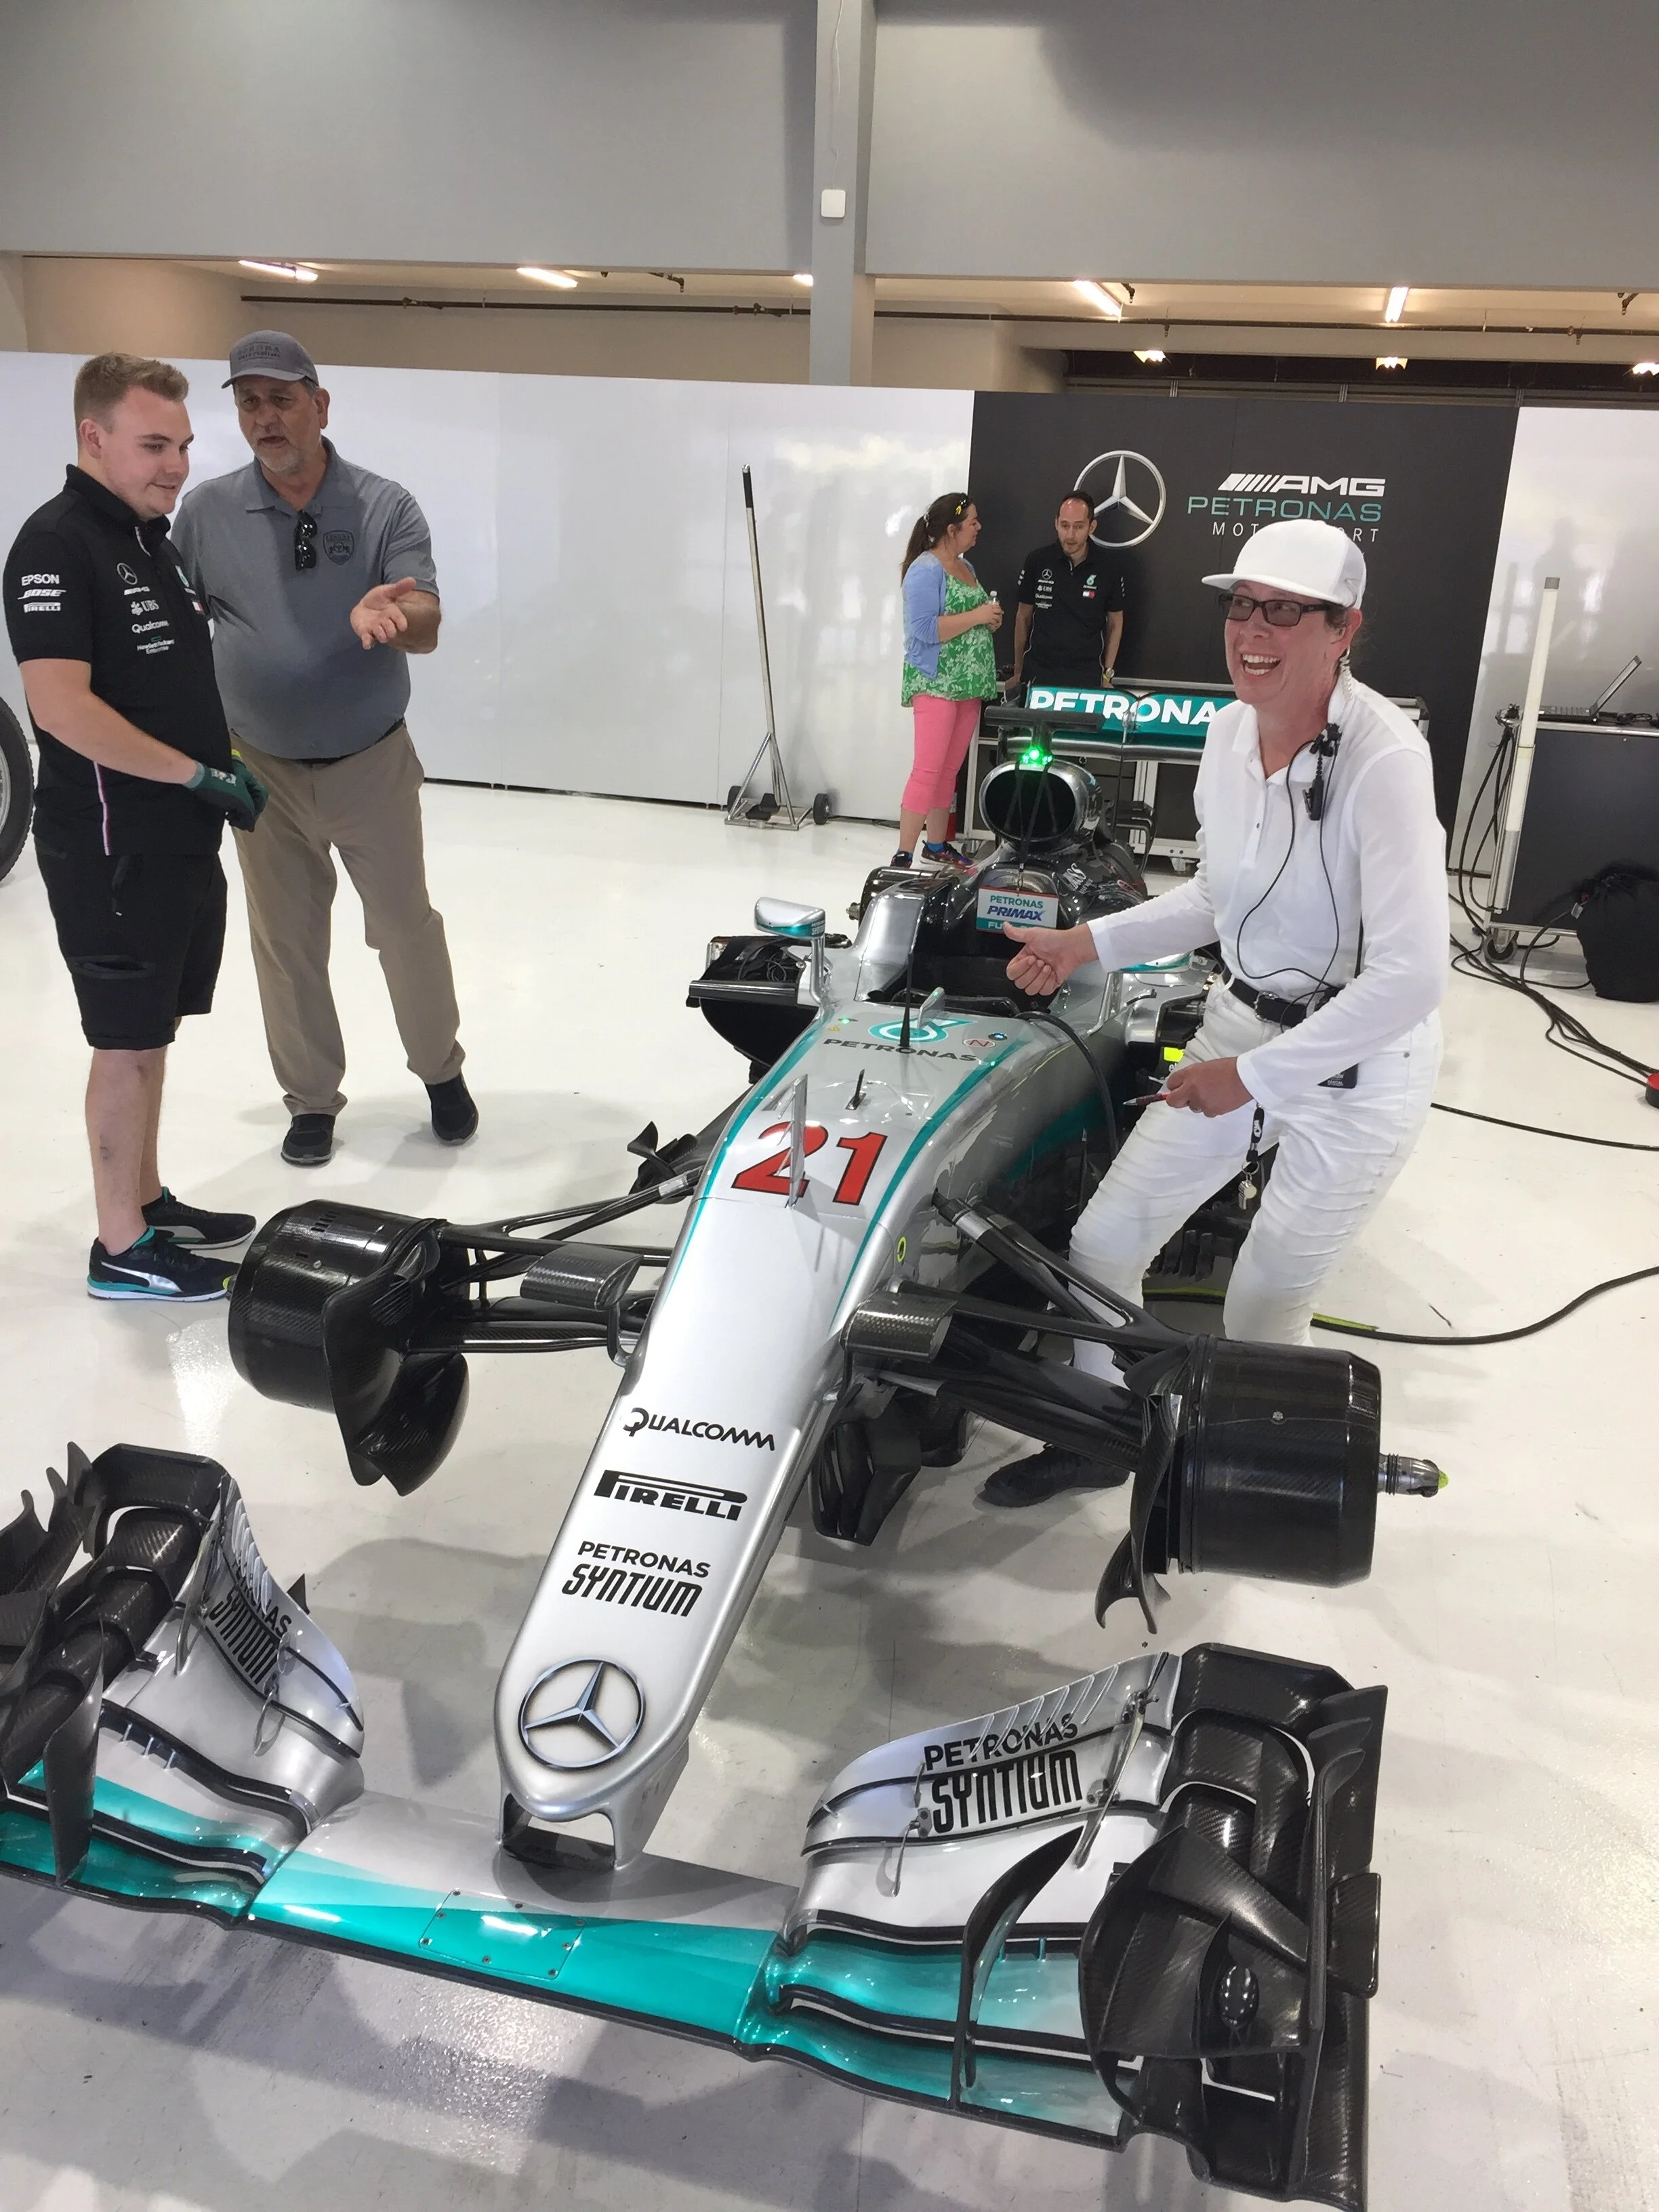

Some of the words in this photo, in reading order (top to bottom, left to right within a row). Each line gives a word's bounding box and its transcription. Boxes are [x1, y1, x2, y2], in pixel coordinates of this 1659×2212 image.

[1269, 474, 1386, 497] AMG
[1187, 496, 1382, 522] PETRONAS
[21, 573, 60, 586] EPSON
[17, 588, 67, 600] BOSE
[141, 599, 160, 611] UBS
[1029, 690, 1218, 725] PETRONA
[987, 905, 1046, 922] PRIMAX
[990, 895, 1044, 909] PETRONAS
[823, 1038, 978, 1062] PETRONAS
[731, 1121, 888, 1206] 21
[593, 1469, 748, 1521] PIRELLI
[577, 1540, 712, 1578] PETRONAS
[561, 1563, 703, 1618] SYNTIUM
[924, 1713, 1078, 1771] PETRONAS
[931, 1749, 1083, 1834] SYNTIUM
